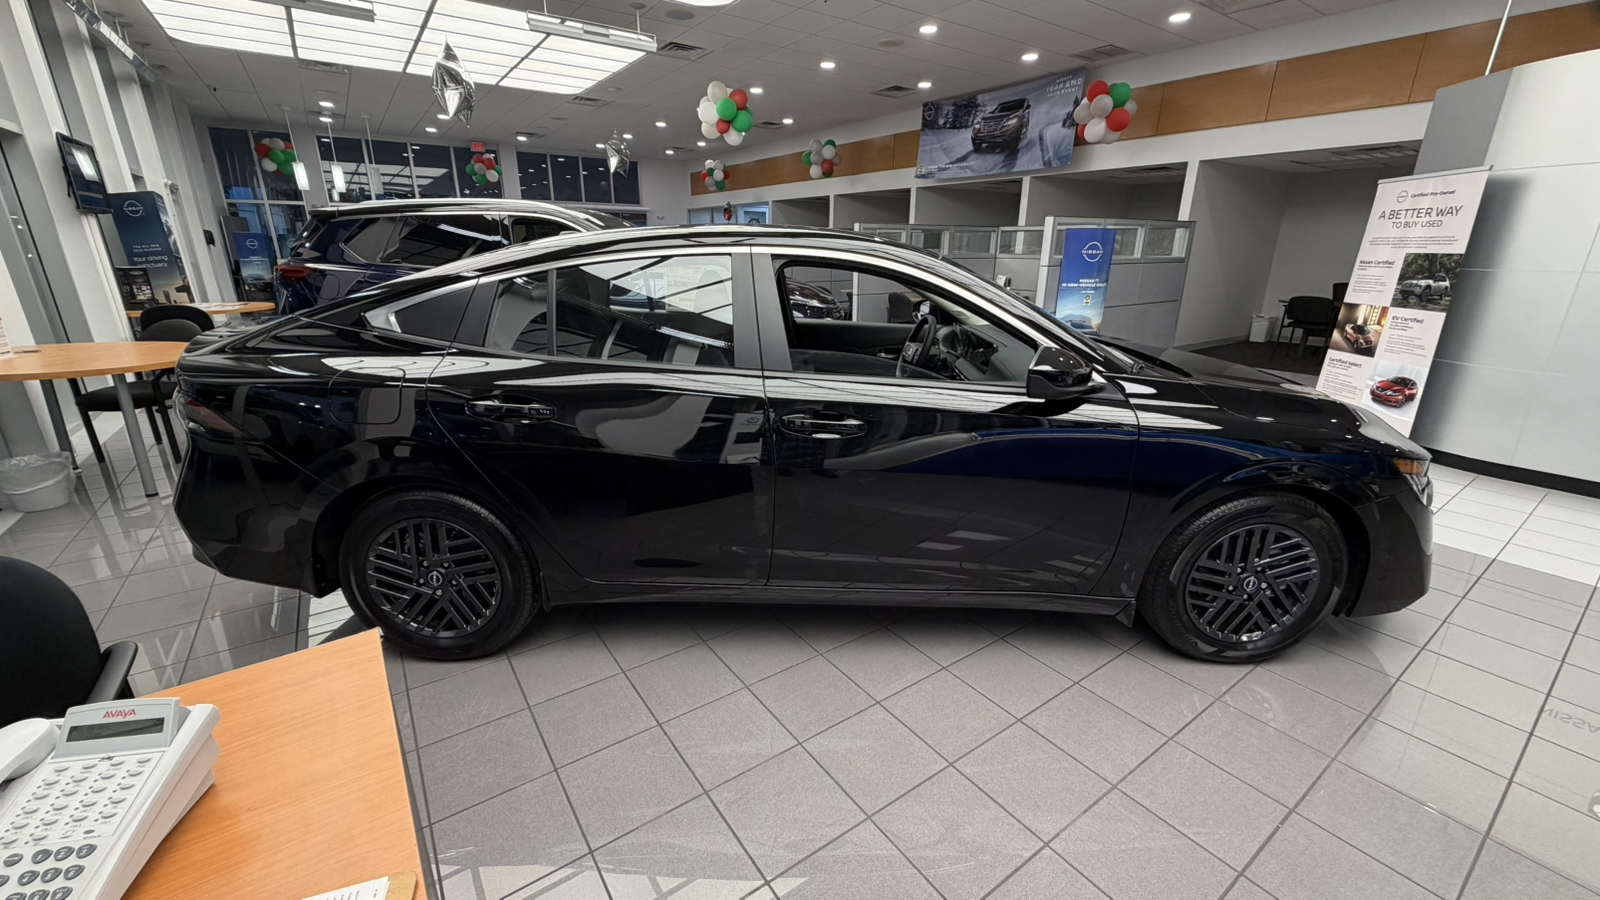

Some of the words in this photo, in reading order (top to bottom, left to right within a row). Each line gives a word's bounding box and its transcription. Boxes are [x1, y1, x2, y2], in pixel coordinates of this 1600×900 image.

[1046, 82, 1064, 92] YEAR
[1066, 78, 1083, 87] END
[1061, 86, 1078, 94] EVENT
[1378, 211, 1386, 220] A
[1388, 208, 1433, 220] BETTER
[1436, 205, 1464, 217] WAY
[1421, 220, 1443, 228] USED
[1400, 316, 1424, 324] Certified
[1329, 357, 1349, 365] Certified
[102, 709, 137, 719] AVAYA
